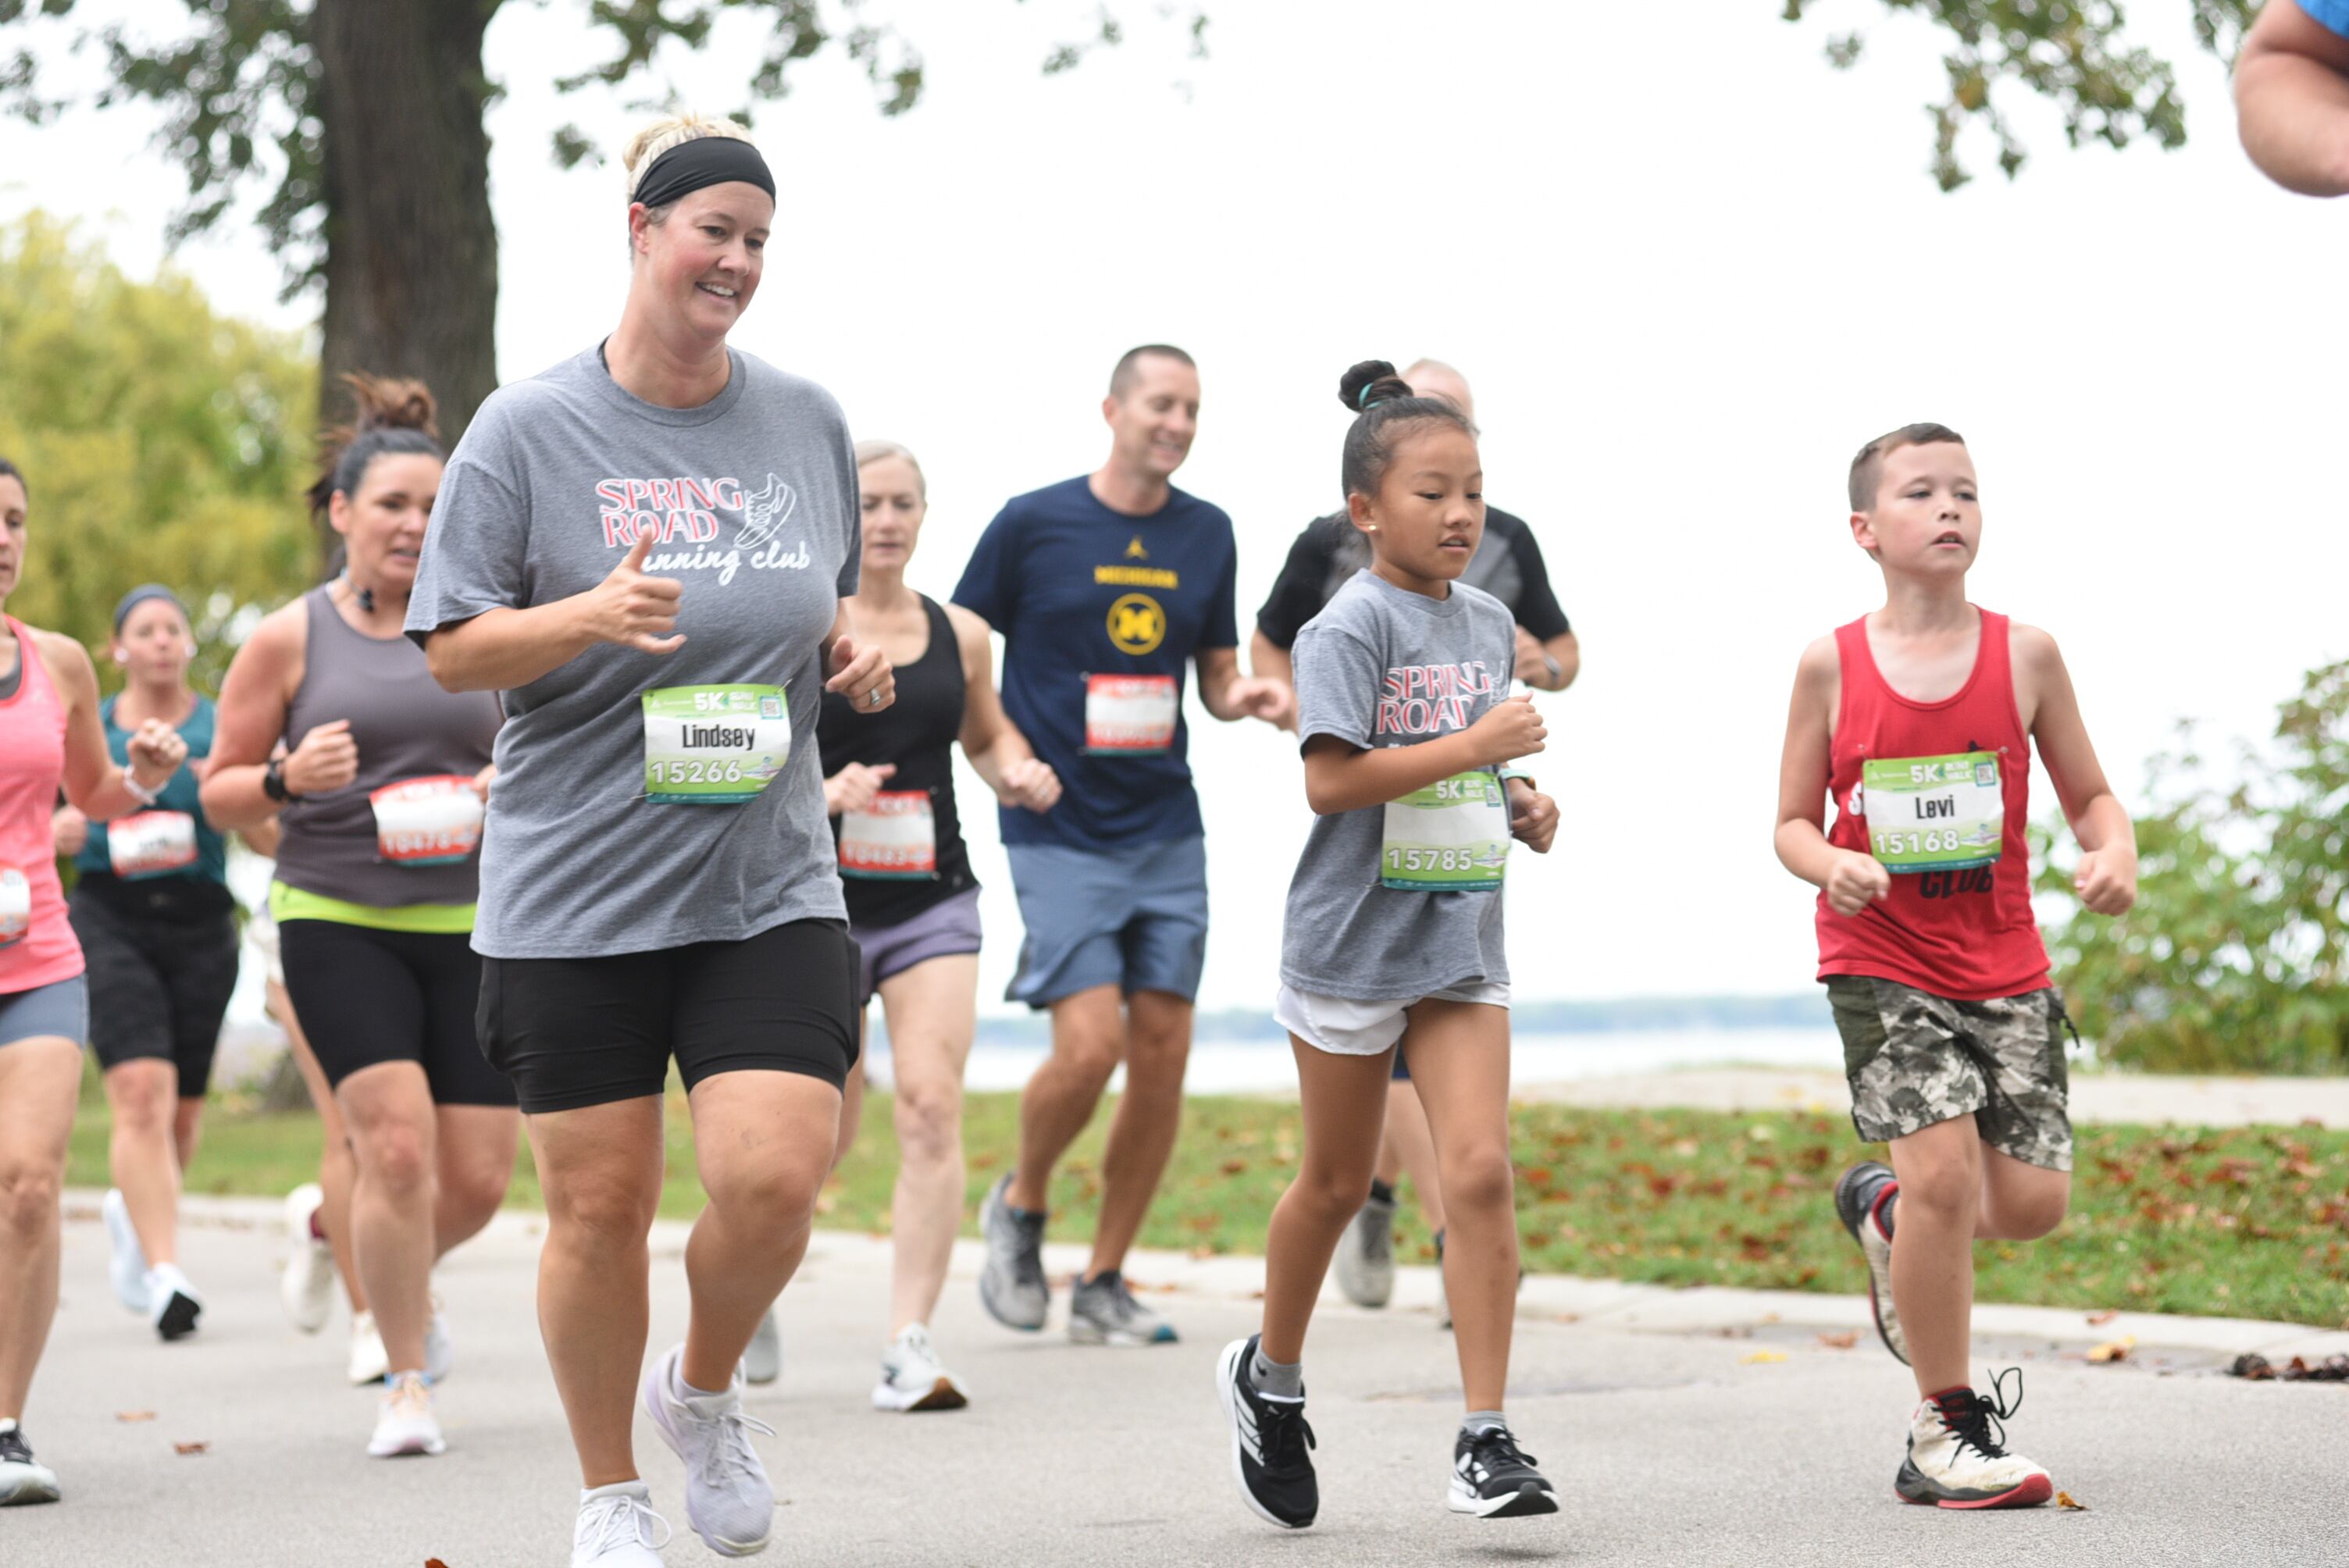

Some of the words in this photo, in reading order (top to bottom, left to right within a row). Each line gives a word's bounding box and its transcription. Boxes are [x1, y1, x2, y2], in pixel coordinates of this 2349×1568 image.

[595, 477, 743, 513] SPRING
[601, 509, 719, 547] ROAD
[750, 540, 811, 569] club
[1380, 661, 1490, 700] SPRING
[694, 692, 725, 711] 5K
[683, 724, 755, 750] Lindsey
[651, 760, 742, 784] 15266
[1910, 763, 1941, 784] 5K
[1436, 780, 1462, 800] 5K
[1916, 795, 1955, 819] Levi
[1875, 830, 1959, 854] 15168
[1388, 848, 1473, 871] 15785
